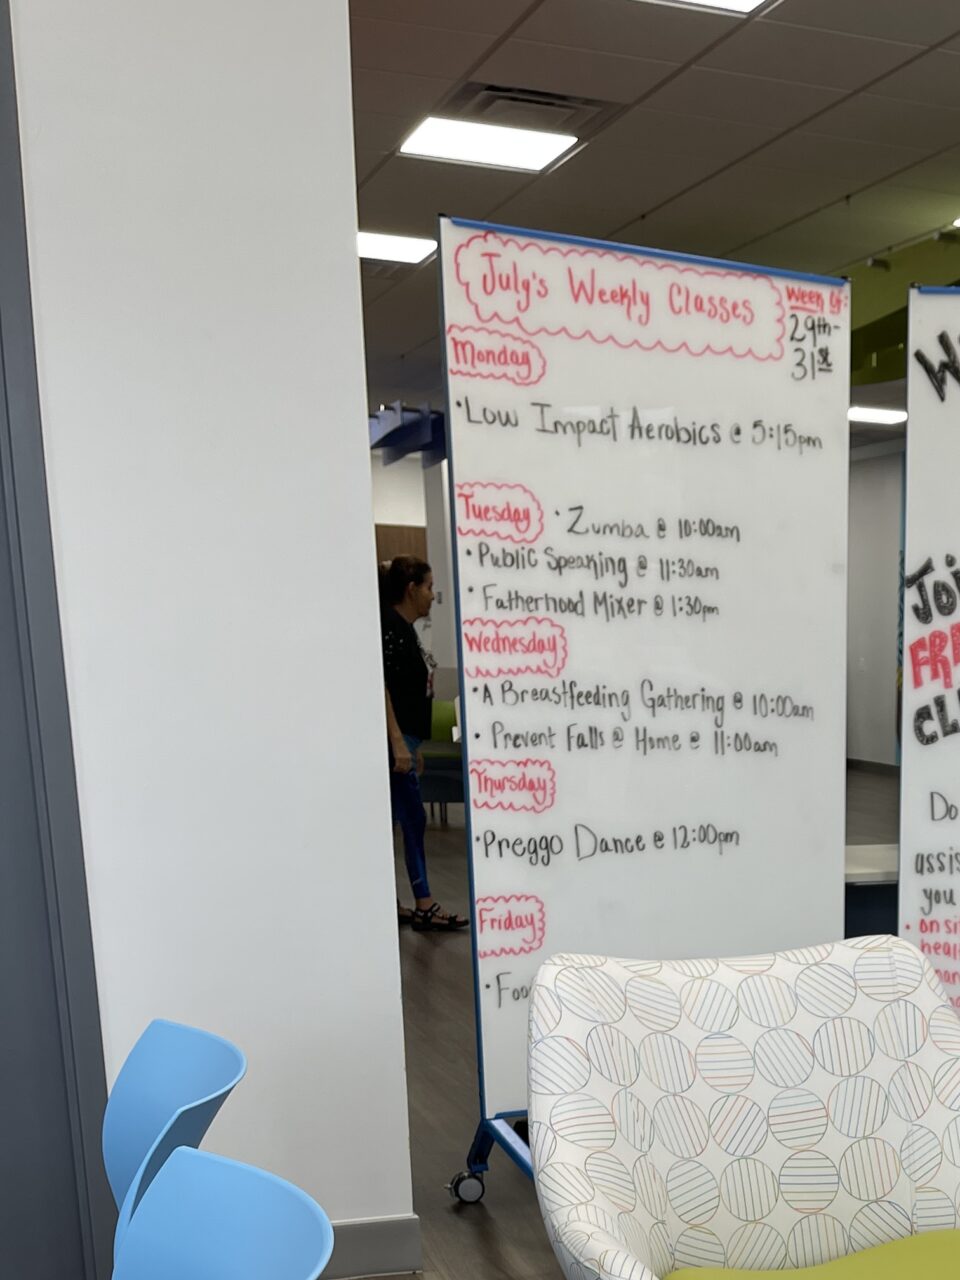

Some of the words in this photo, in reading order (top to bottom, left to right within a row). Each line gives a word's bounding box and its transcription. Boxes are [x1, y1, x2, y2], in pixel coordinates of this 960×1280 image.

[481, 253, 549, 312] July's
[568, 268, 650, 325] Weekly
[669, 283, 755, 324] Classes
[786, 285, 824, 314] Week
[451, 337, 531, 379] Monday
[465, 397, 519, 427] Low
[531, 403, 620, 447] Impact
[630, 406, 721, 447] Aerobics
[752, 420, 823, 455] 5:15pm
[458, 493, 531, 533] Tuesday
[568, 505, 650, 537] Zumba
[678, 519, 740, 543] 10:00am
[479, 543, 538, 569] Public
[544, 546, 629, 587] Speaking
[659, 558, 719, 581] 11:30am
[482, 584, 585, 616] Fatherhood
[594, 592, 648, 622] Mixer
[672, 593, 719, 622] 1:30pm
[464, 631, 558, 669] Wednesday
[501, 680, 630, 721] Breastfeeding
[640, 679, 725, 728] Gathering
[752, 694, 814, 721] 10:00am
[492, 721, 556, 749] Prevent
[567, 723, 605, 752] Falls
[635, 727, 682, 756] Home
[714, 731, 779, 756] 11:00am
[470, 764, 548, 805] Thursday
[930, 792, 958, 820] Do
[483, 829, 563, 866] Preggo
[574, 824, 646, 861] Dance
[673, 824, 740, 855] 12:00pm
[921, 890, 958, 915] you
[478, 907, 535, 945] Friday
